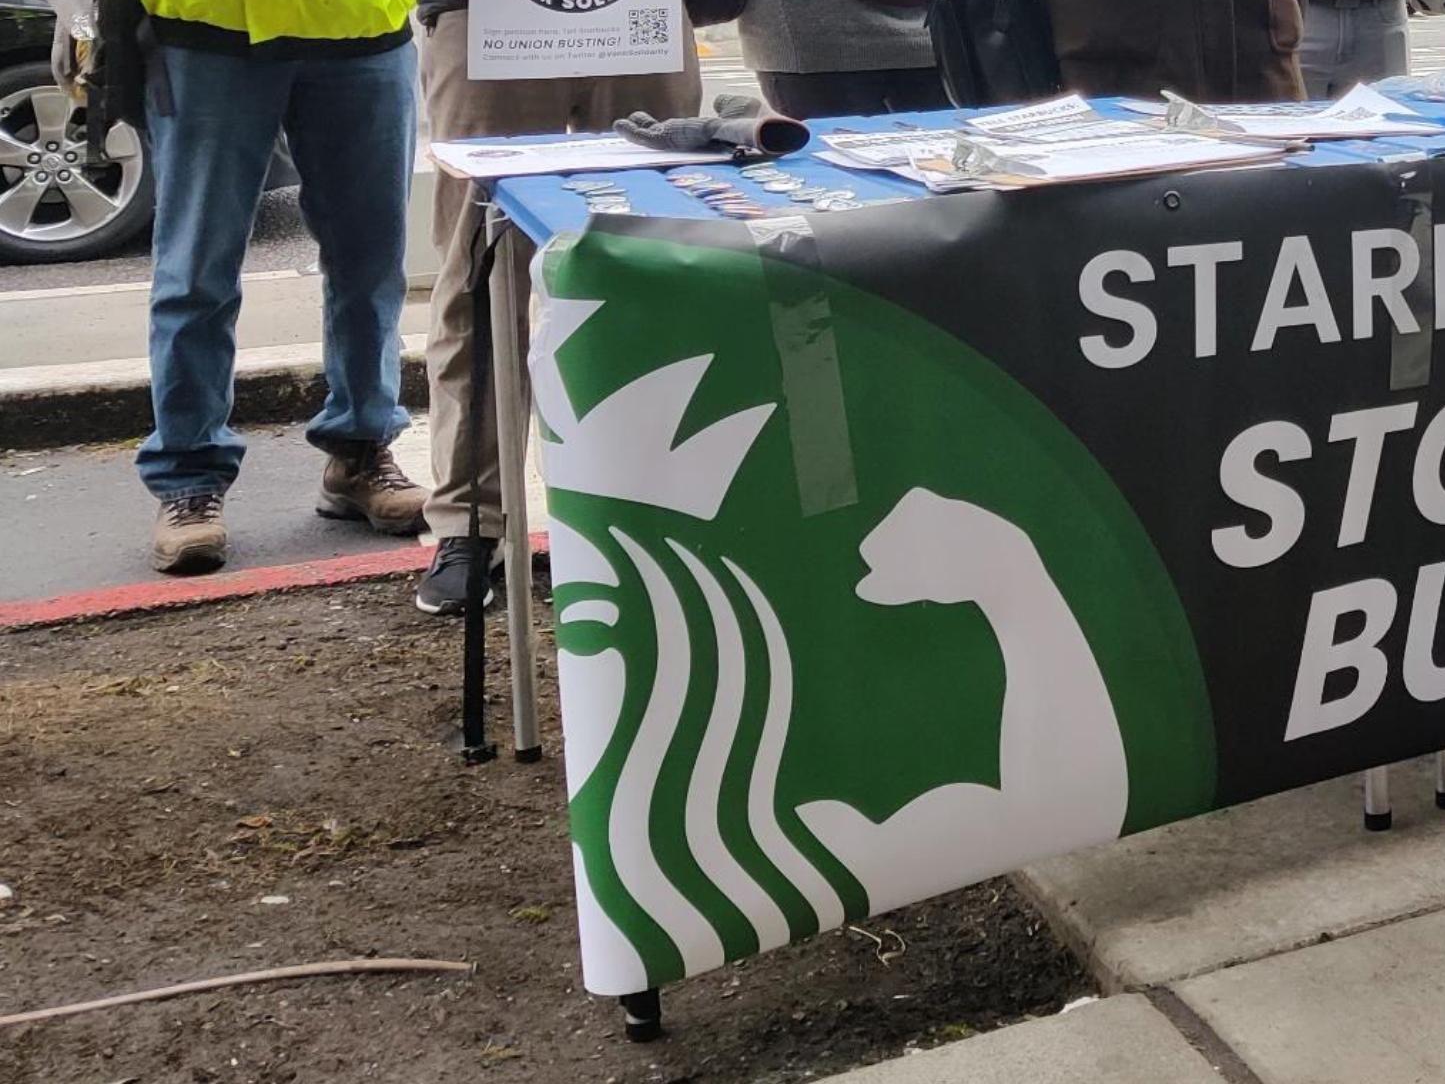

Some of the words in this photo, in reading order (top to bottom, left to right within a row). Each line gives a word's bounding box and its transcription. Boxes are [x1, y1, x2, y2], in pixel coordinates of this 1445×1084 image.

[482, 39, 504, 50] NO
[508, 38, 553, 50] UNION
[558, 36, 622, 48] BUSTING!
